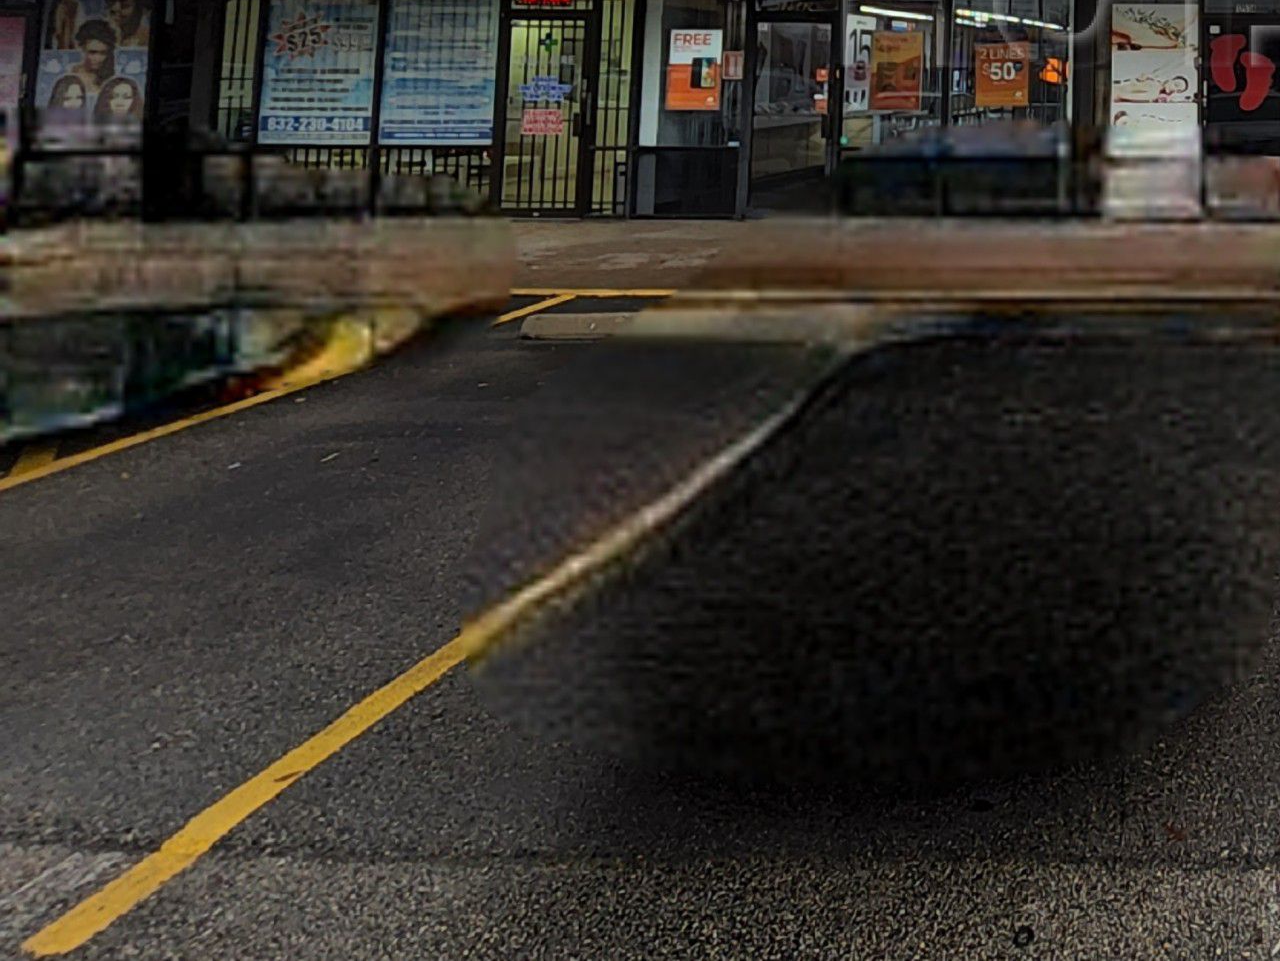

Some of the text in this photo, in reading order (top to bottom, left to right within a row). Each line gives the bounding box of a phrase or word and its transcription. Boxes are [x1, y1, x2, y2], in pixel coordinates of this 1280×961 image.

[673, 33, 712, 46] FREE
[980, 47, 1025, 59] 2 LINES
[982, 61, 1016, 80] $50
